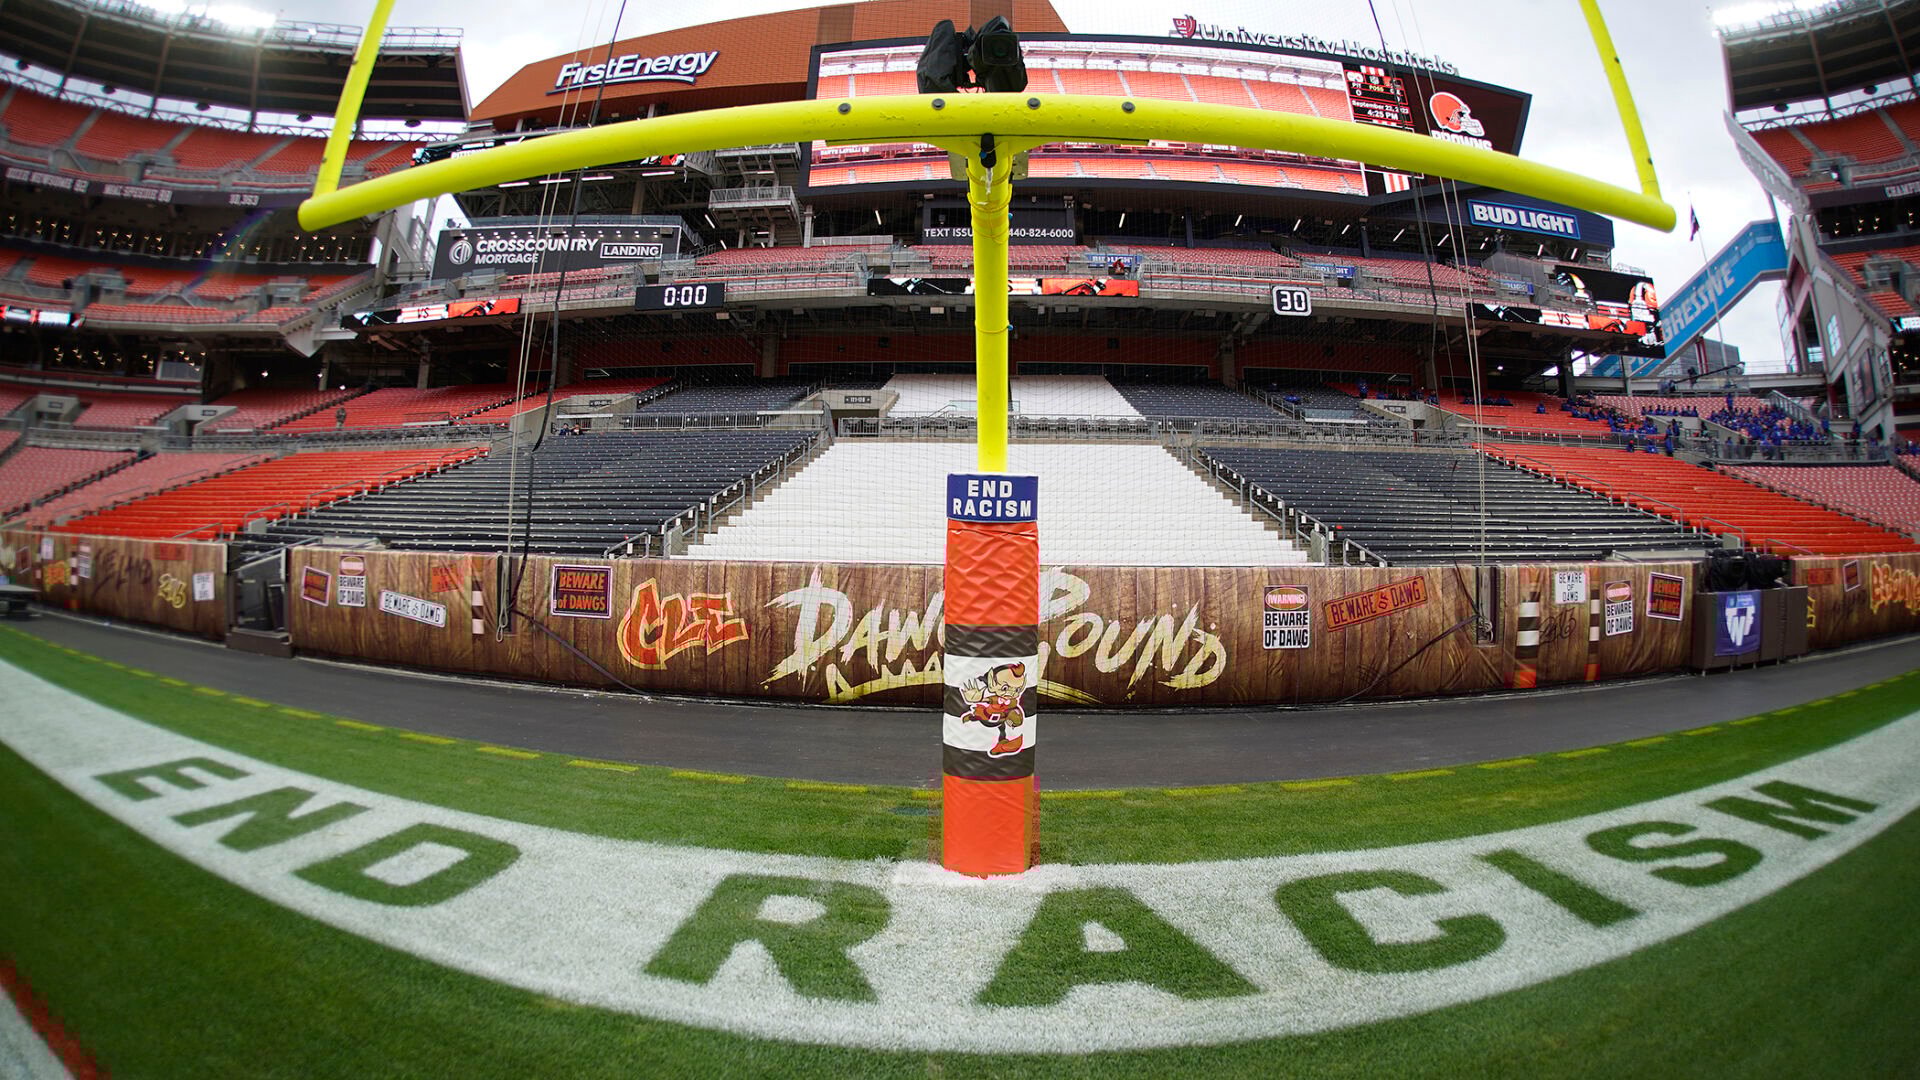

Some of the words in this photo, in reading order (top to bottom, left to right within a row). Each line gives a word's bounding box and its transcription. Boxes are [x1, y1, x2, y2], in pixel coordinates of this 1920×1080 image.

[1199, 23, 1336, 54] University
[1341, 38, 1459, 76] Hospitals
[555, 50, 720, 88] FirstEnergy
[1351, 99, 1384, 110] September
[1385, 111, 1398, 120] PM
[1472, 203, 1518, 225] BUD
[1518, 210, 1575, 234] LIGHT
[924, 228, 950, 237] TEXT
[952, 228, 973, 237] ISSU
[1008, 228, 1074, 238] 440-824-6000
[476, 238, 600, 253] CROSSCOUNTRY
[603, 245, 660, 256] LANDING
[475, 253, 539, 265] MORTGAGE
[663, 285, 708, 306] 0:00
[1280, 290, 1306, 312] 30
[417, 307, 430, 319] VS
[1557, 312, 1571, 326] VS
[967, 479, 1013, 498] END
[952, 498, 1032, 518] RACISM
[558, 571, 605, 590] BEWARE
[1558, 572, 1583, 584] BEWARE
[557, 594, 569, 610] of
[569, 594, 607, 612] DAWGS
[1331, 595, 1377, 625] BEWARE
[1390, 580, 1422, 608] DAWG
[1562, 592, 1579, 602] DAWG
[384, 593, 411, 616] BEWARE
[420, 602, 442, 623] DAWG
[1606, 602, 1632, 617] BEWARE
[617, 577, 749, 671] CLE
[762, 563, 945, 690] DAW
[1264, 612, 1309, 627] BEWARE
[1615, 616, 1632, 632] DAWG
[1264, 629, 1277, 648] OF
[1278, 629, 1309, 648] DAWG
[90, 756, 523, 909] END
[641, 780, 1880, 1008] RACISM
